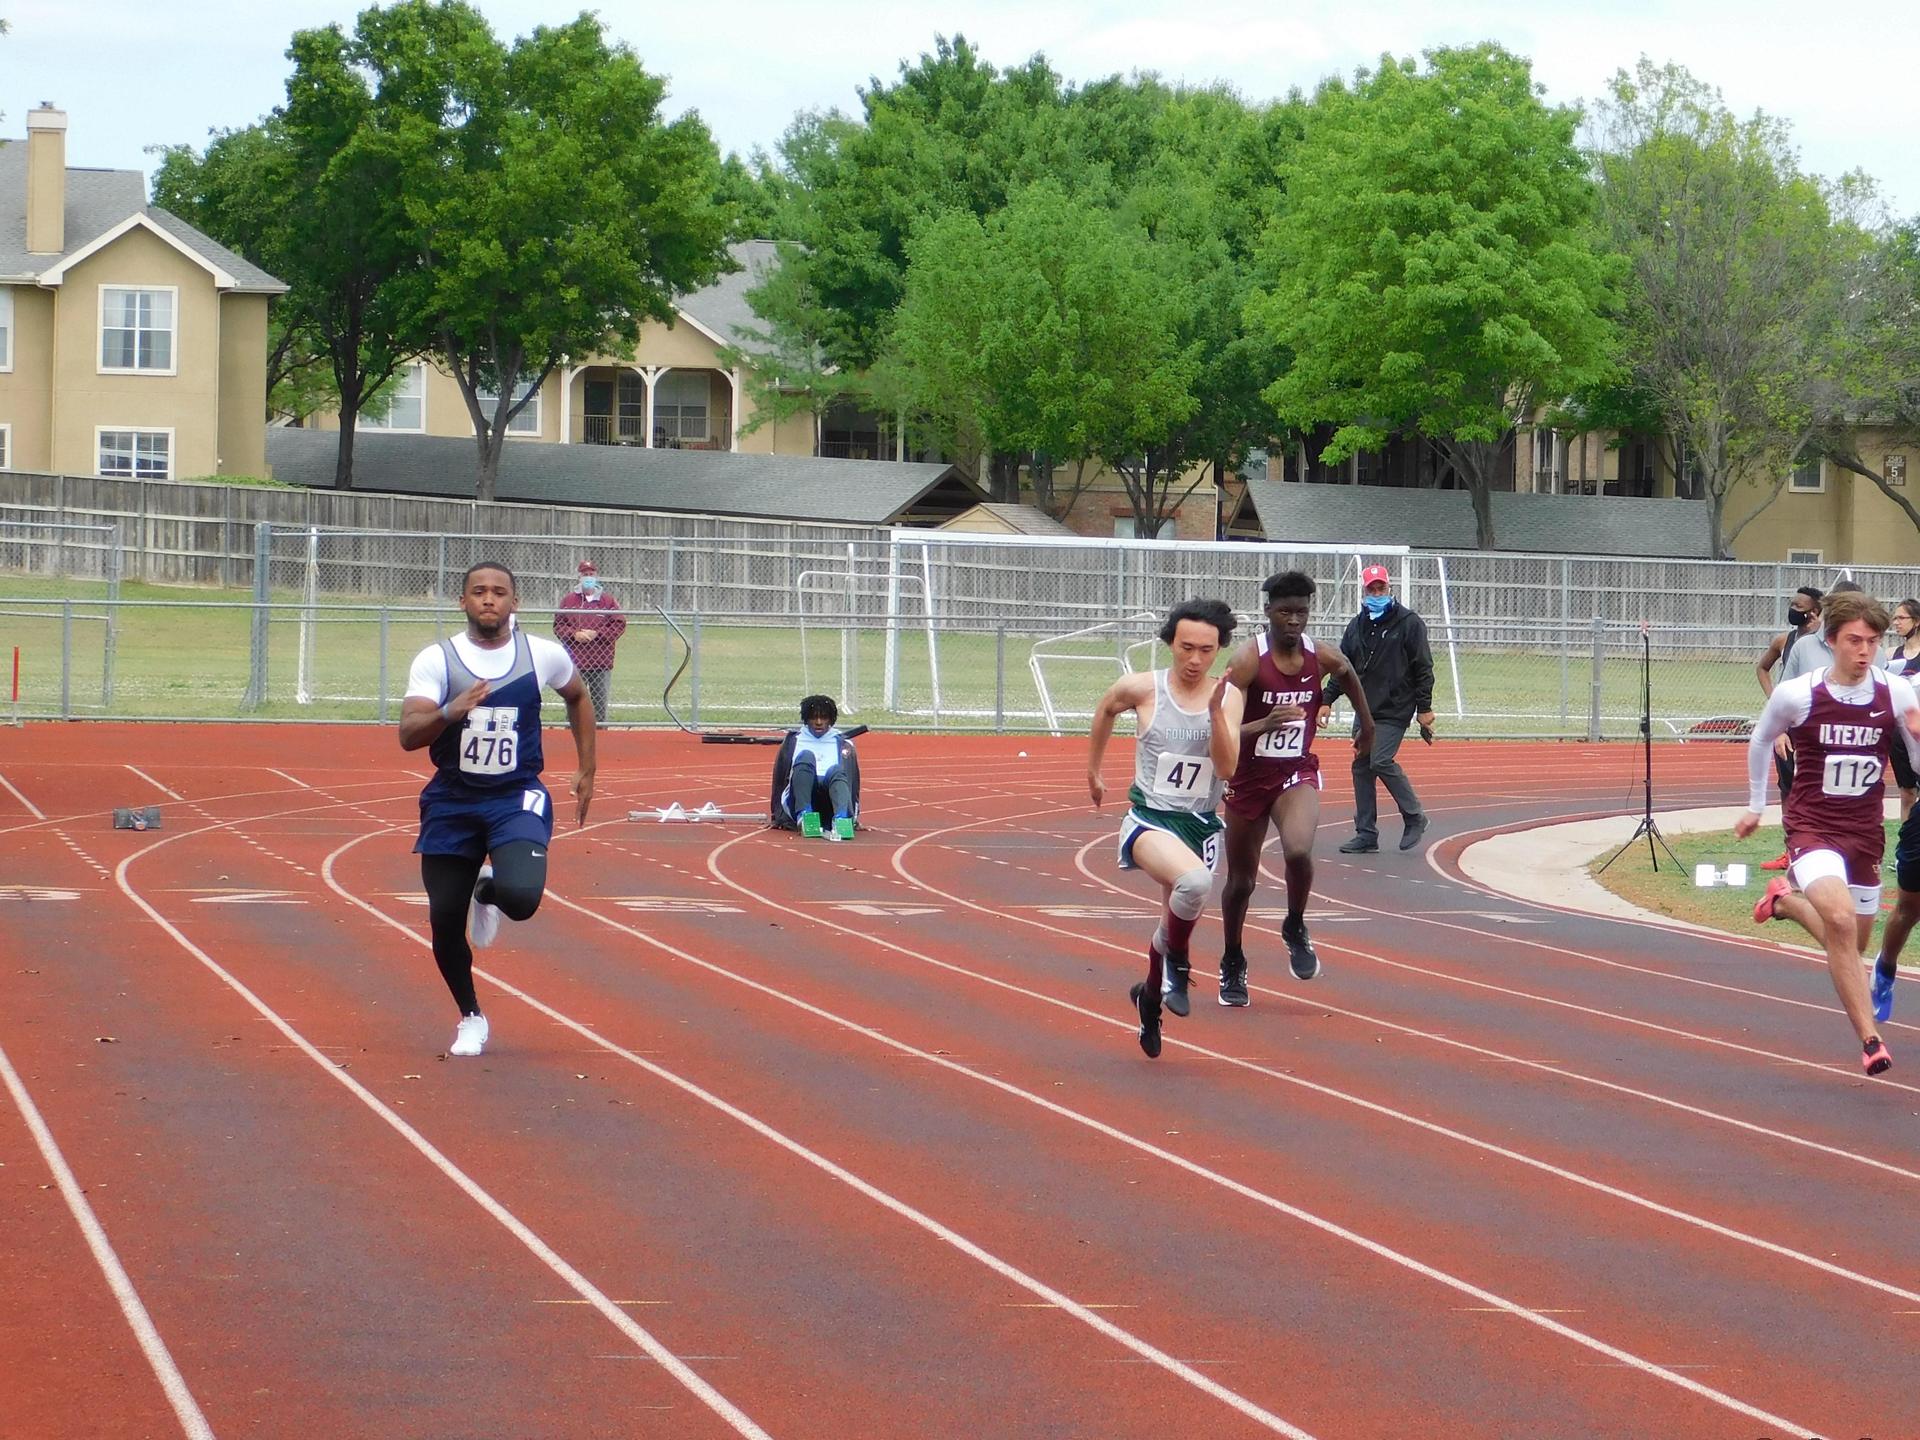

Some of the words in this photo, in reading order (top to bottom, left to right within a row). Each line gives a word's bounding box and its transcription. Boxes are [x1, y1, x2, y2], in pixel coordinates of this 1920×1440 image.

[1891, 466, 1899, 478] 5
[1276, 691, 1313, 705] TEXAS
[1265, 727, 1300, 750] 152
[464, 736, 513, 766] 476
[1167, 761, 1201, 790] 47
[1833, 760, 1877, 787] 112
[528, 790, 542, 811] 7
[1206, 836, 1216, 862] 5
